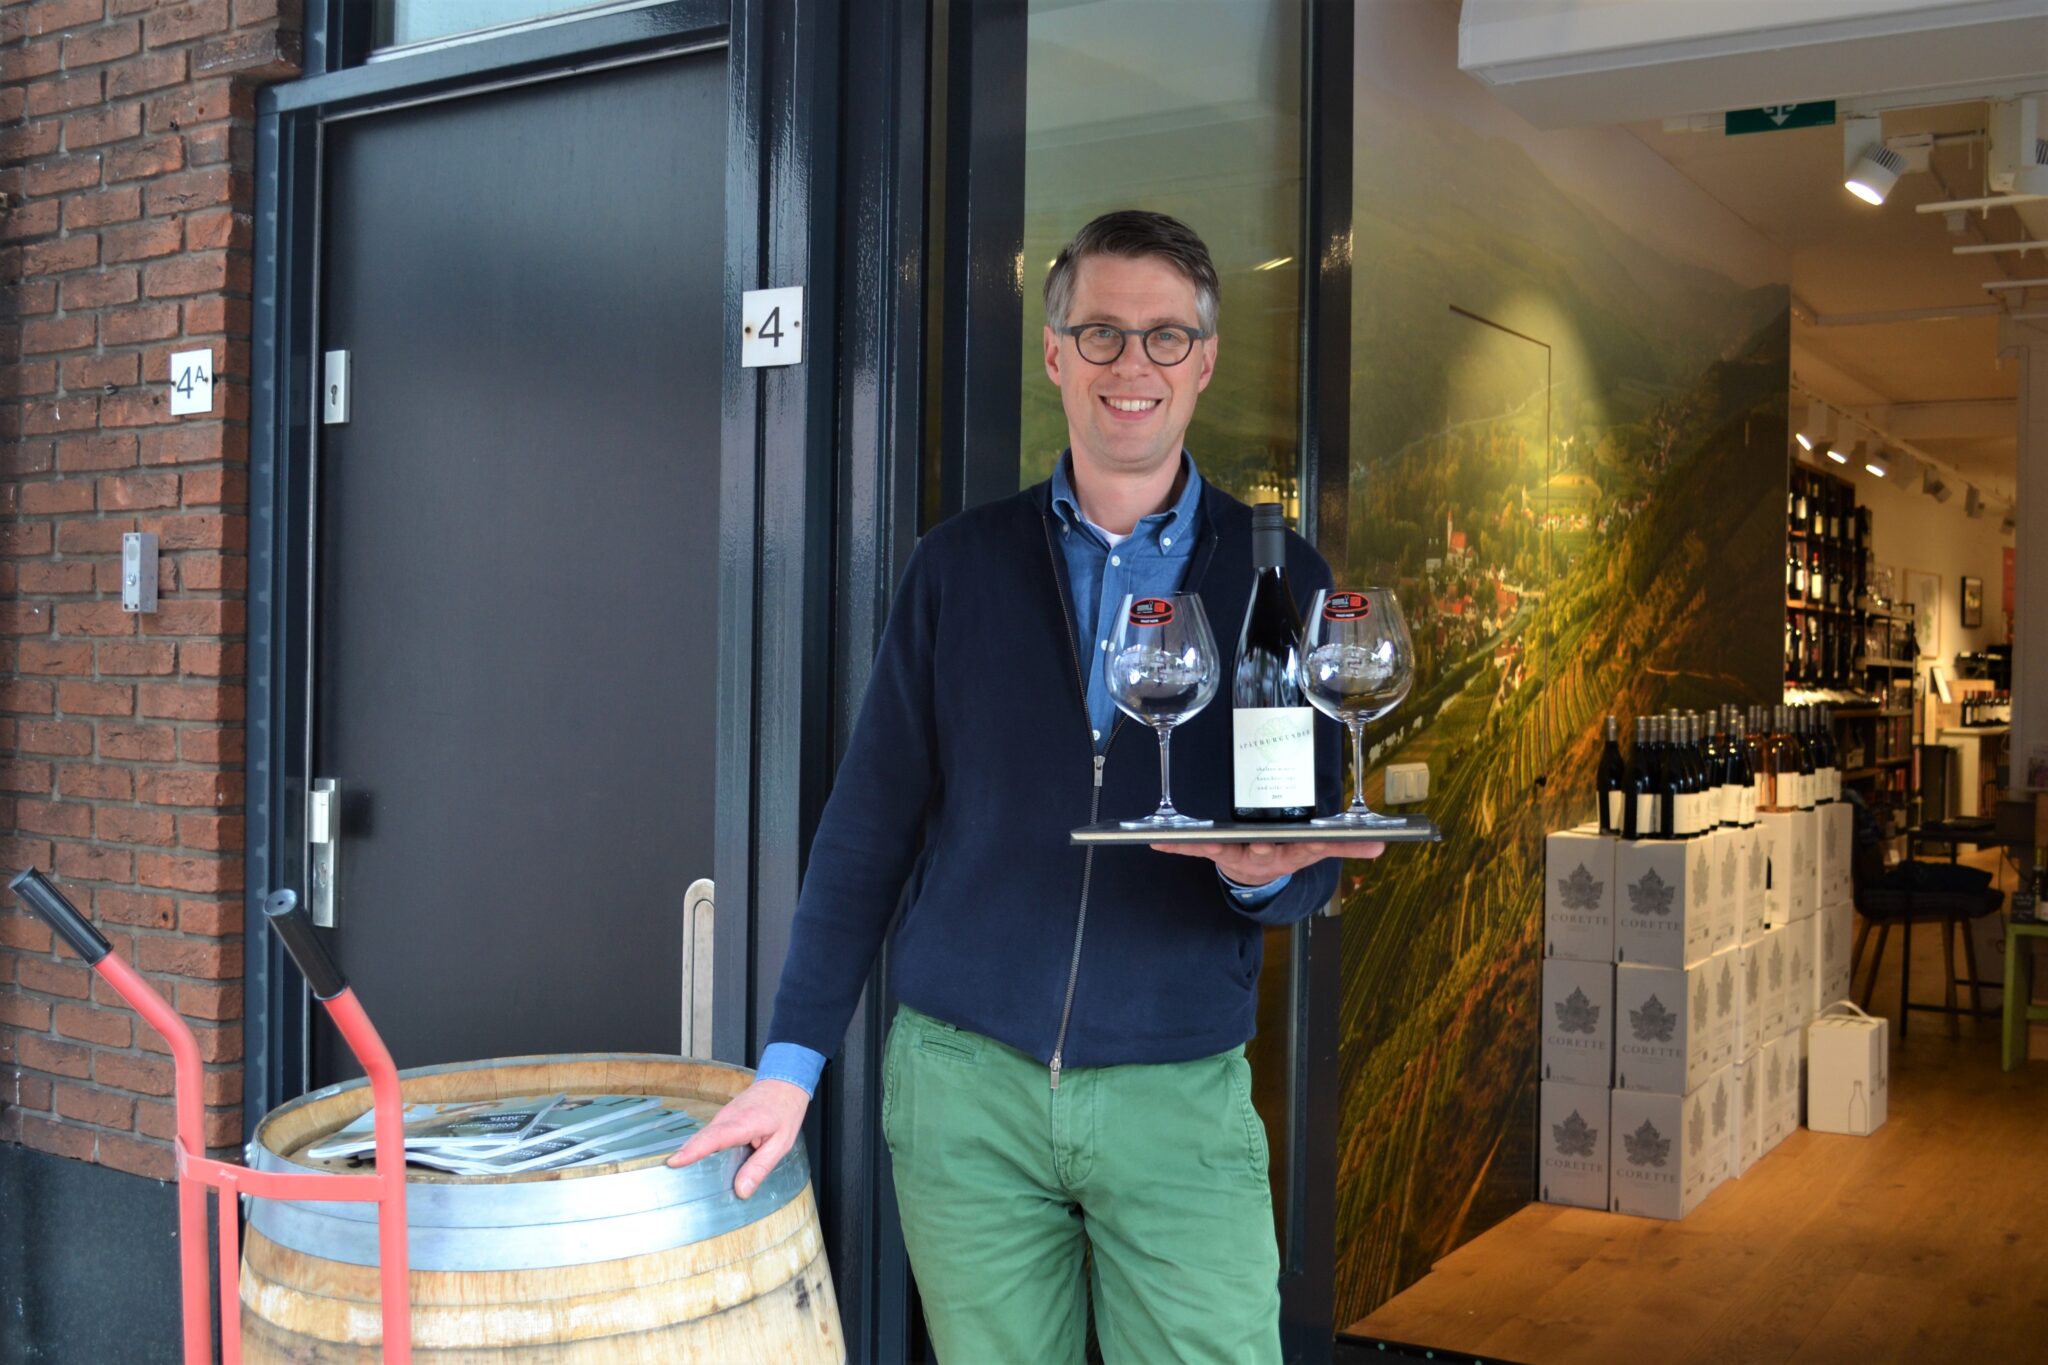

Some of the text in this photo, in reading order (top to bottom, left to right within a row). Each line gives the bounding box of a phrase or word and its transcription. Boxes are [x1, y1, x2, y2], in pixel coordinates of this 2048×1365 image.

[758, 306, 784, 348] 4
[1551, 914, 1609, 926] CORETTE
[1620, 919, 1681, 931] CORETTE
[1547, 1036, 1606, 1049] CORETTE
[1621, 1044, 1683, 1058] CORETTE
[1545, 1158, 1603, 1172] CORETTE
[1615, 1168, 1677, 1183] CORETTE
